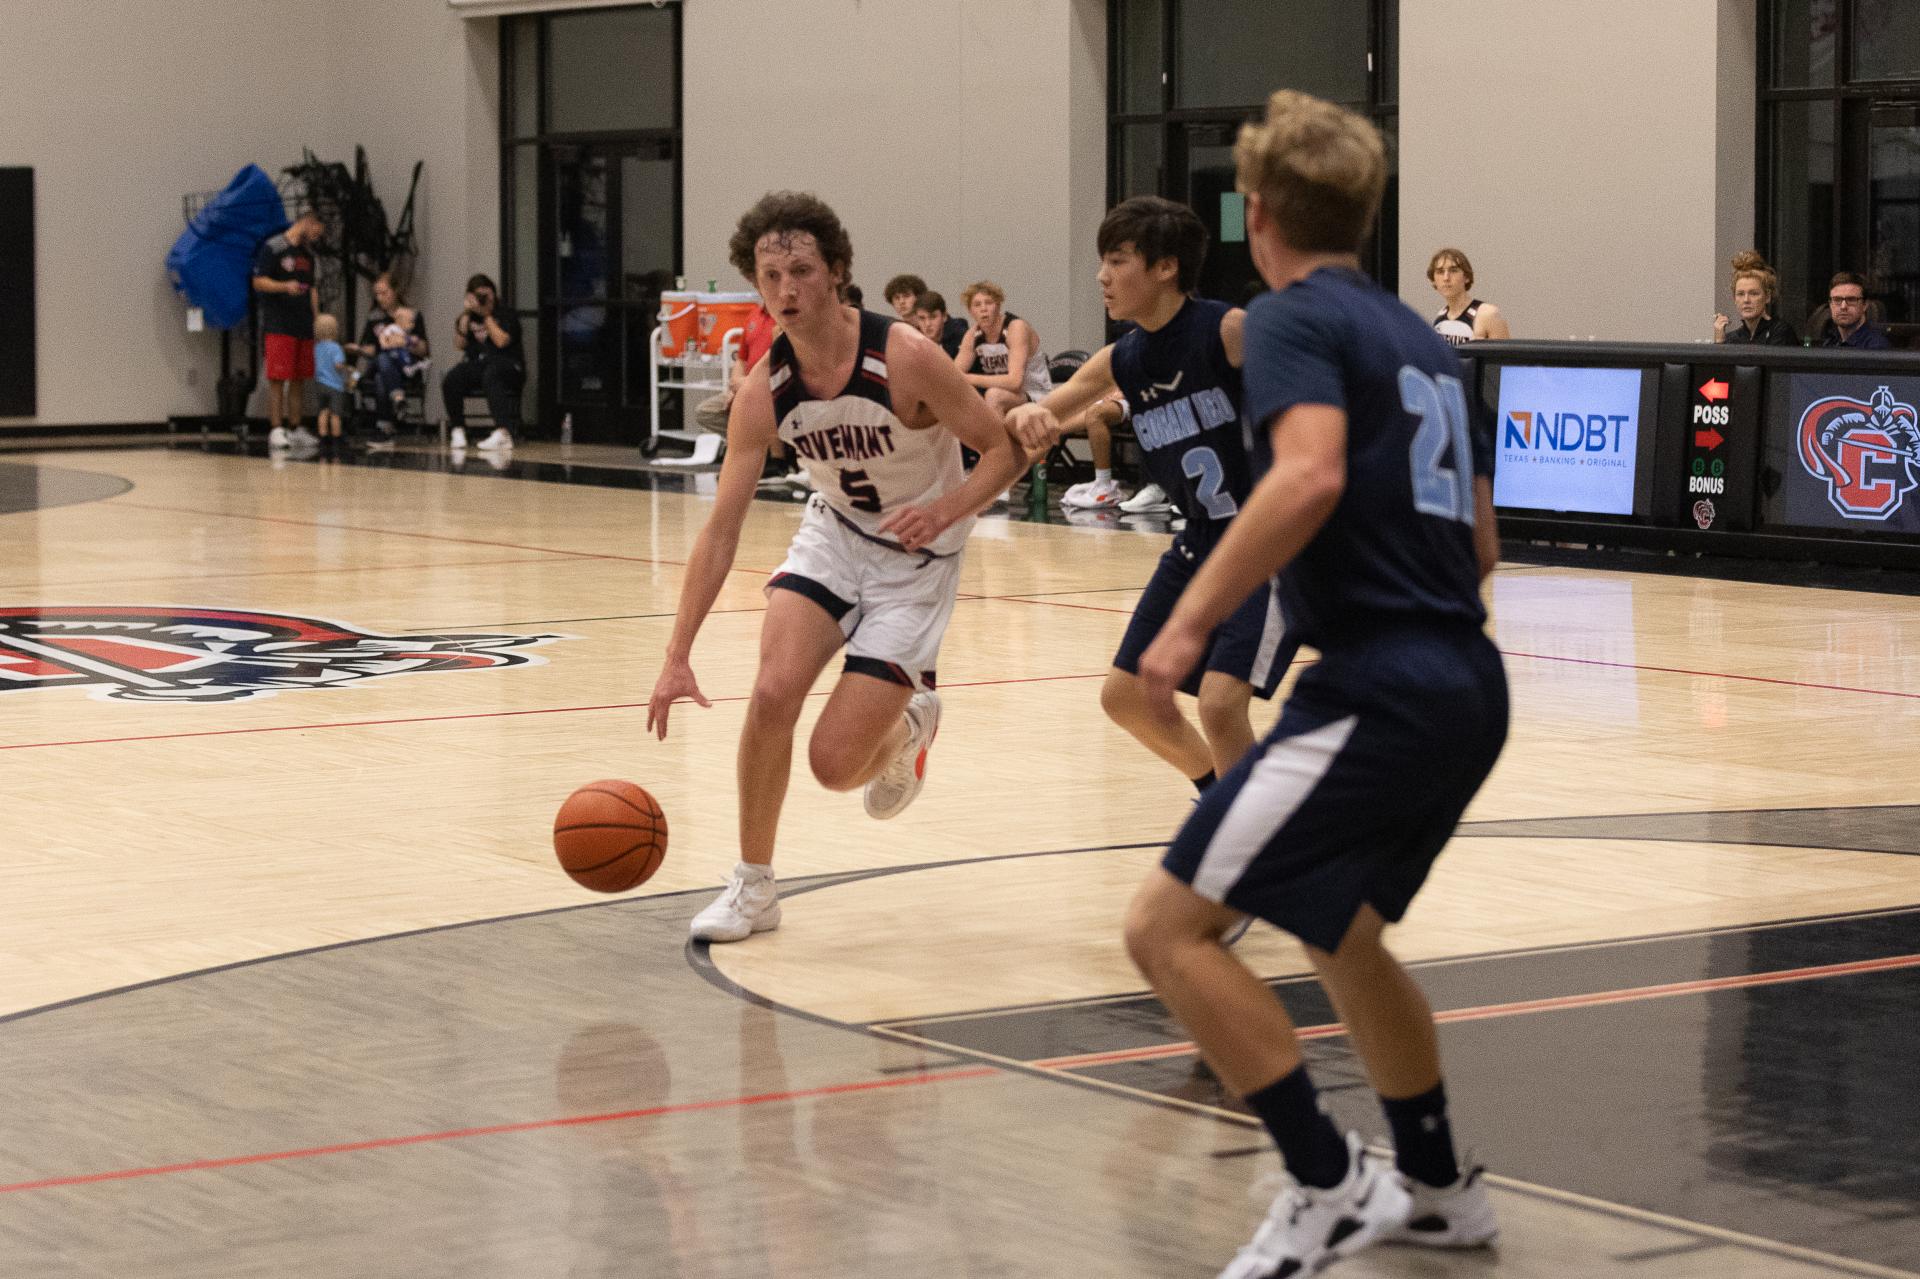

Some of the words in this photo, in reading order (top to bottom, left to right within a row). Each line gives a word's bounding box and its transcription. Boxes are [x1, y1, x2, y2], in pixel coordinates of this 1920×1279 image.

[1535, 412, 1629, 452] NDBT
[1693, 405, 1729, 425] POSS
[793, 424, 895, 461] OVENANT
[1398, 365, 1475, 528] 21
[1504, 454, 1529, 463] TEXAS
[1540, 456, 1576, 465] BANKING
[1587, 458, 1627, 468] ORIGINAL
[839, 467, 882, 513] 5
[1181, 446, 1238, 520] 2
[1689, 476, 1724, 494] BONUS
[1837, 429, 1897, 512] C
